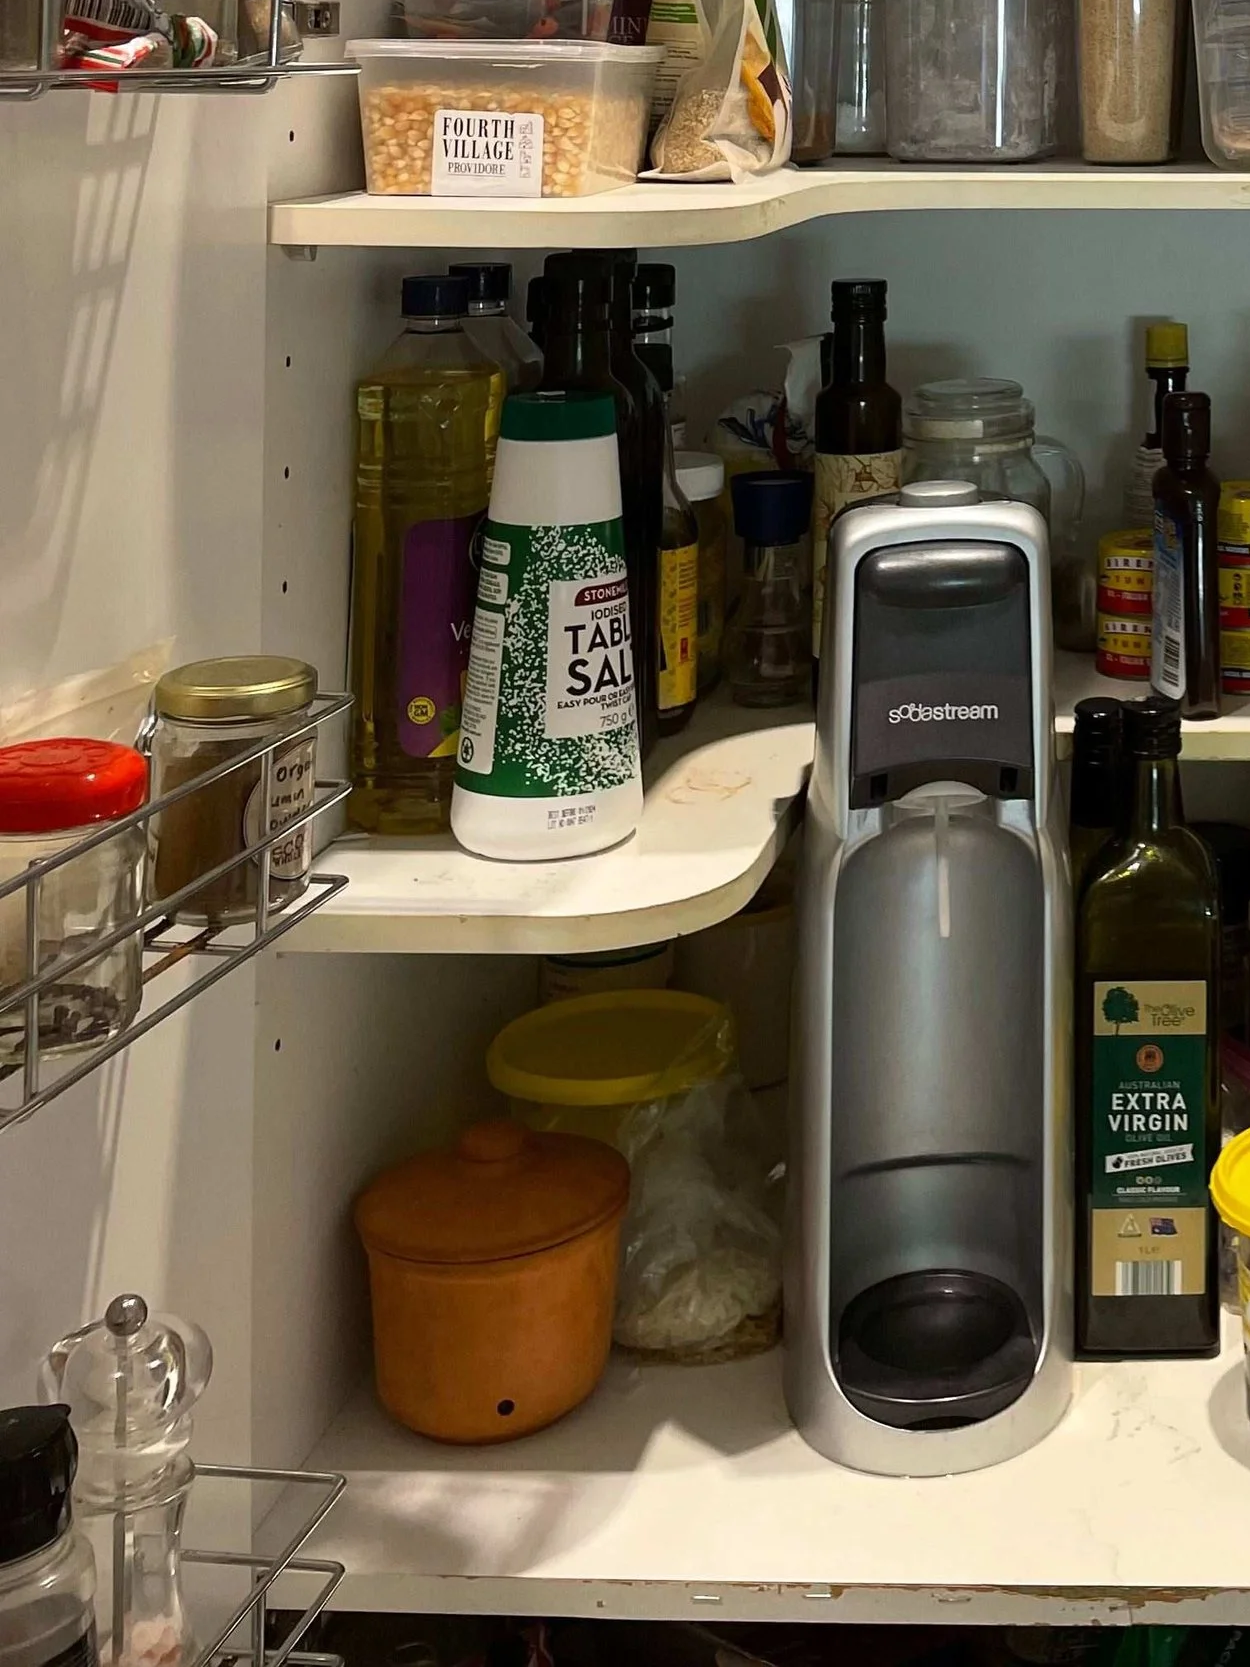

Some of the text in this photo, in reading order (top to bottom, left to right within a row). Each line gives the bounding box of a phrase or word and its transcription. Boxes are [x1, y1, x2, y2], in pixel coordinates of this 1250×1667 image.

[443, 117, 515, 139] FOURTH
[443, 139, 515, 160] VILLAGE
[448, 162, 506, 175] PROVIDORE
[591, 602, 627, 621] IODISED
[564, 613, 631, 655] TABL
[566, 646, 632, 697] SAL
[557, 690, 618, 709] EASY POUR OR
[600, 697, 622, 710] TWIST
[600, 712, 620, 728] 750
[888, 703, 999, 724] sodastream
[277, 760, 311, 782] Orga
[1160, 1003, 1196, 1017] Olive
[1151, 1014, 1182, 1027] Tree
[1118, 1081, 1181, 1090] AUSTRALIAN
[1111, 1092, 1187, 1111] EXTRA
[1108, 1114, 1188, 1132] VIRGIN
[1125, 1134, 1173, 1142] OLIVE OIL
[1124, 1155, 1154, 1168] FRESH
[1156, 1151, 1187, 1165] OLIVES
